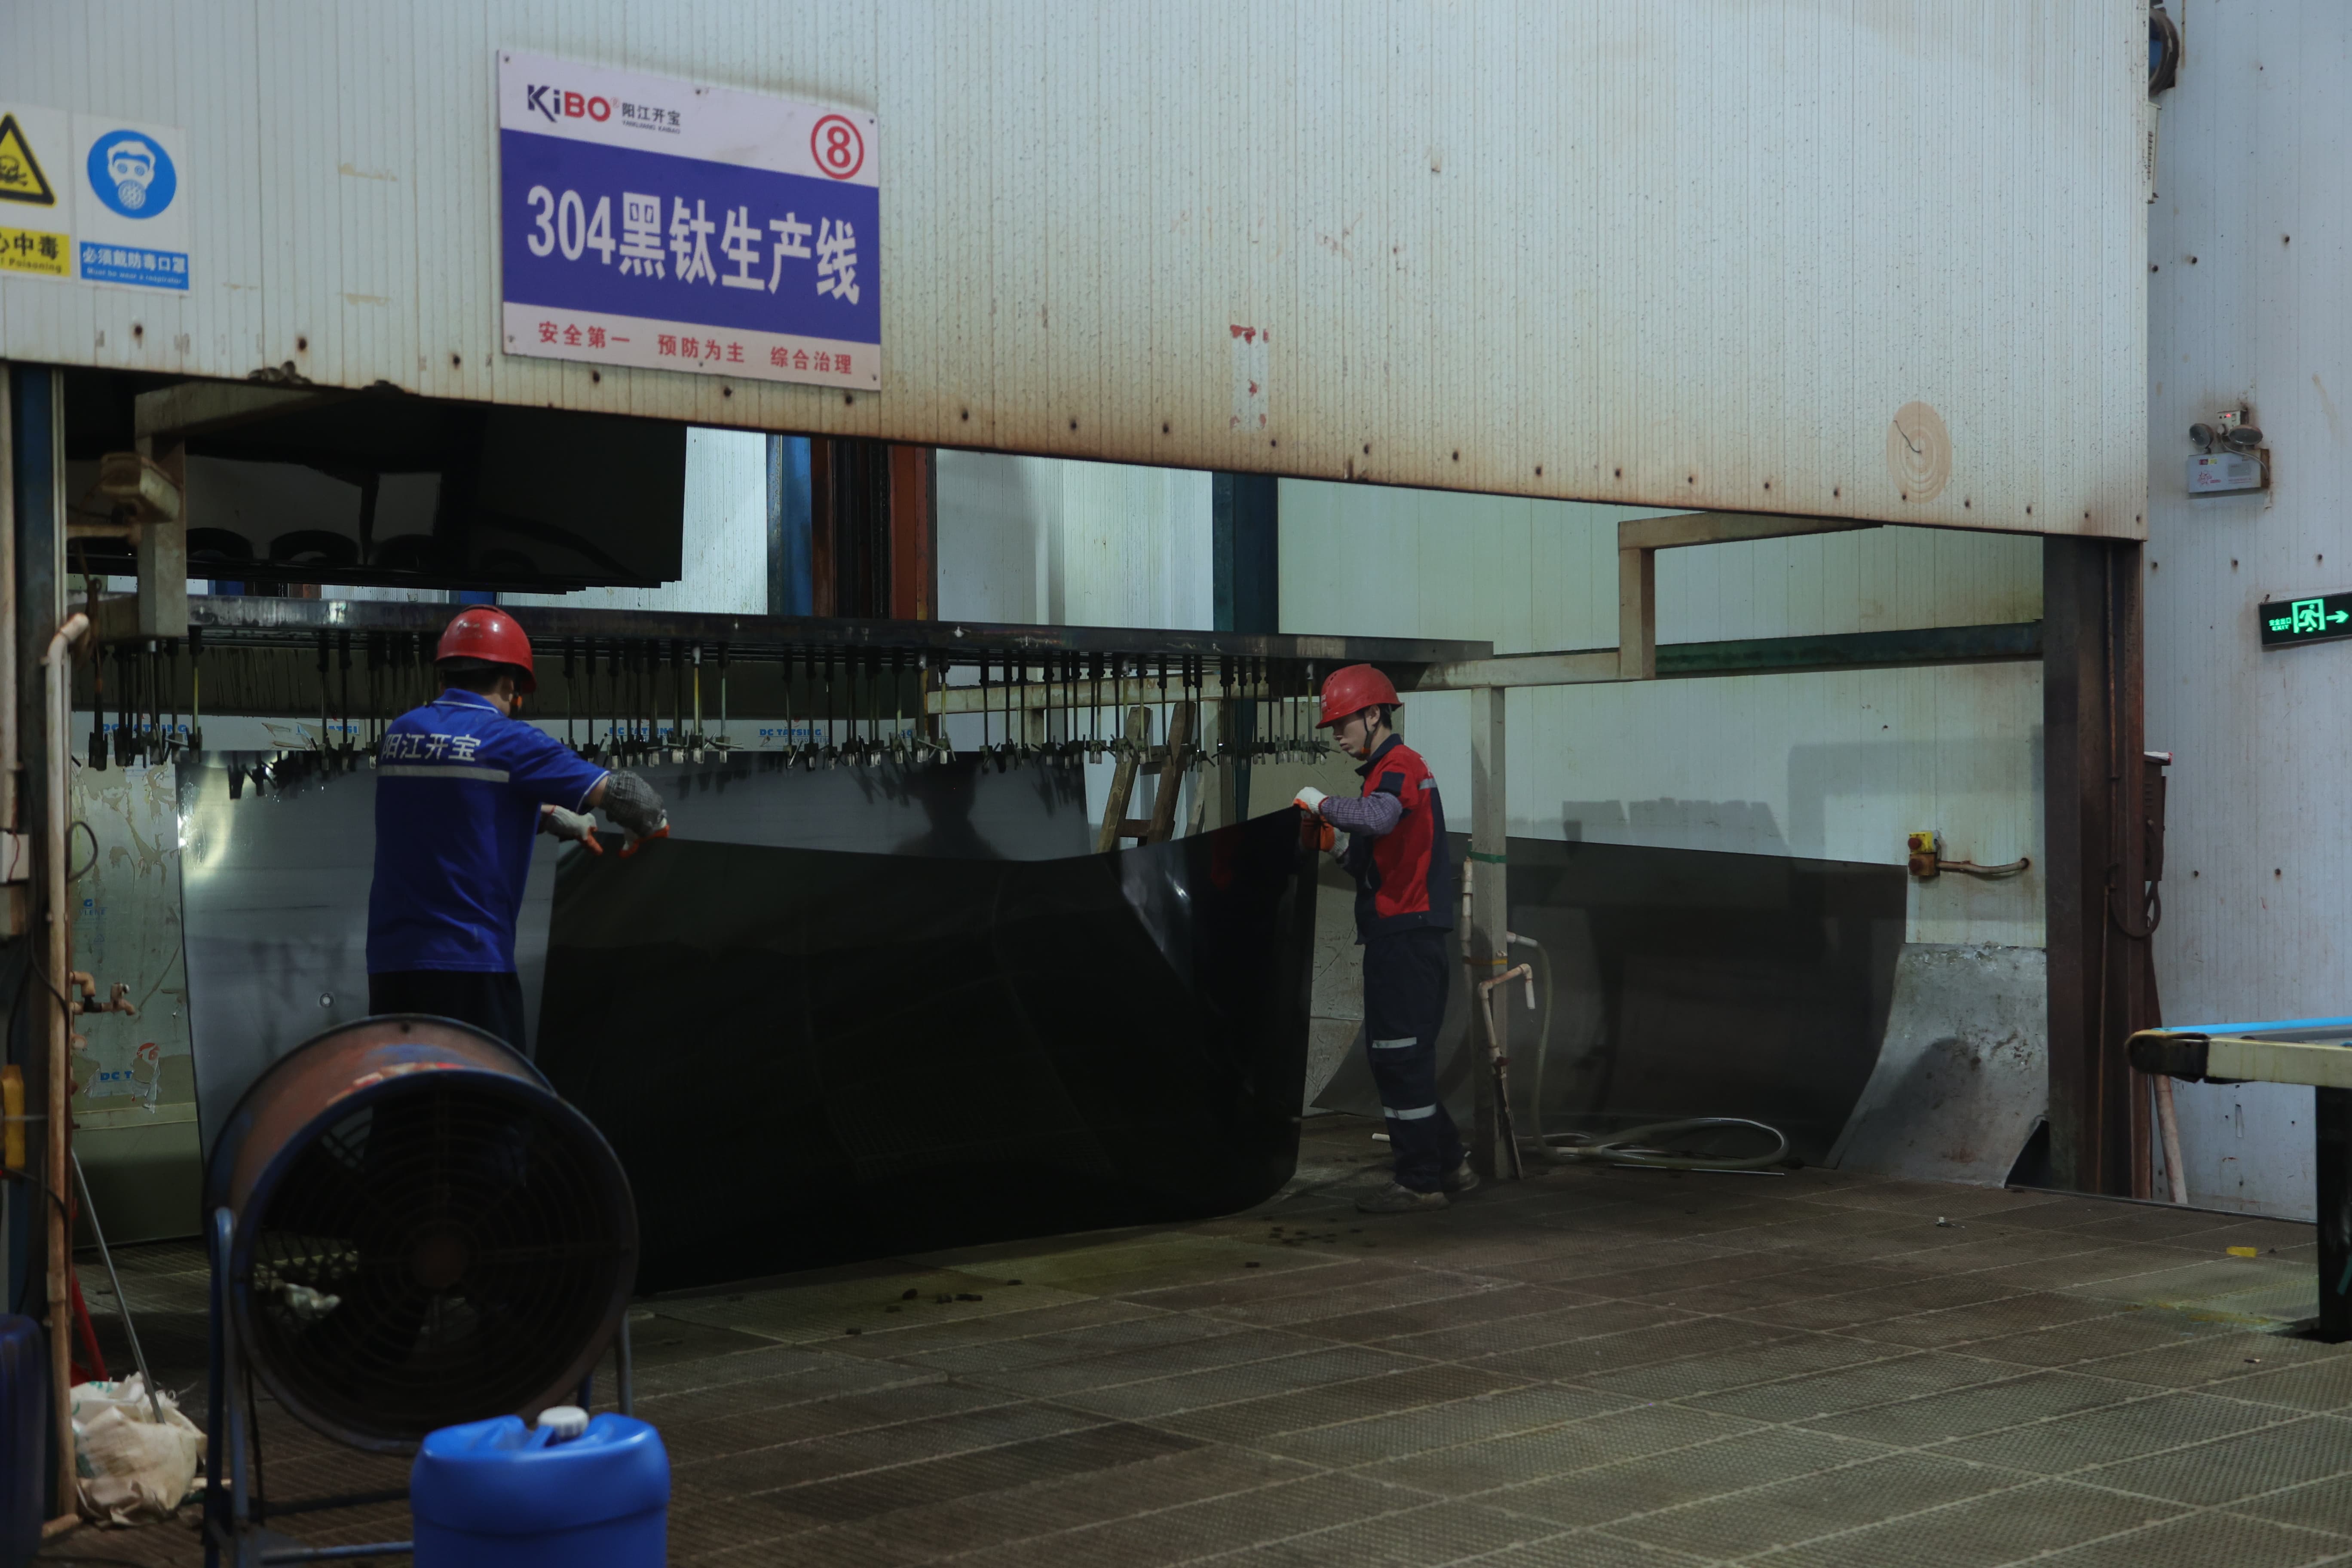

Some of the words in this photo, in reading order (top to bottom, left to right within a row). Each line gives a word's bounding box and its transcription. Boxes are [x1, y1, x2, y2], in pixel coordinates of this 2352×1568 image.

[622, 102, 681, 126] 阳江开宝
[527, 185, 860, 306] 304黑钛生产线
[538, 321, 630, 349] 安全第一
[657, 334, 745, 364] 预防为主
[770, 346, 852, 375] 综合治理
[2269, 617, 2291, 626] 安全出口
[380, 733, 481, 762] 阳江开宝
